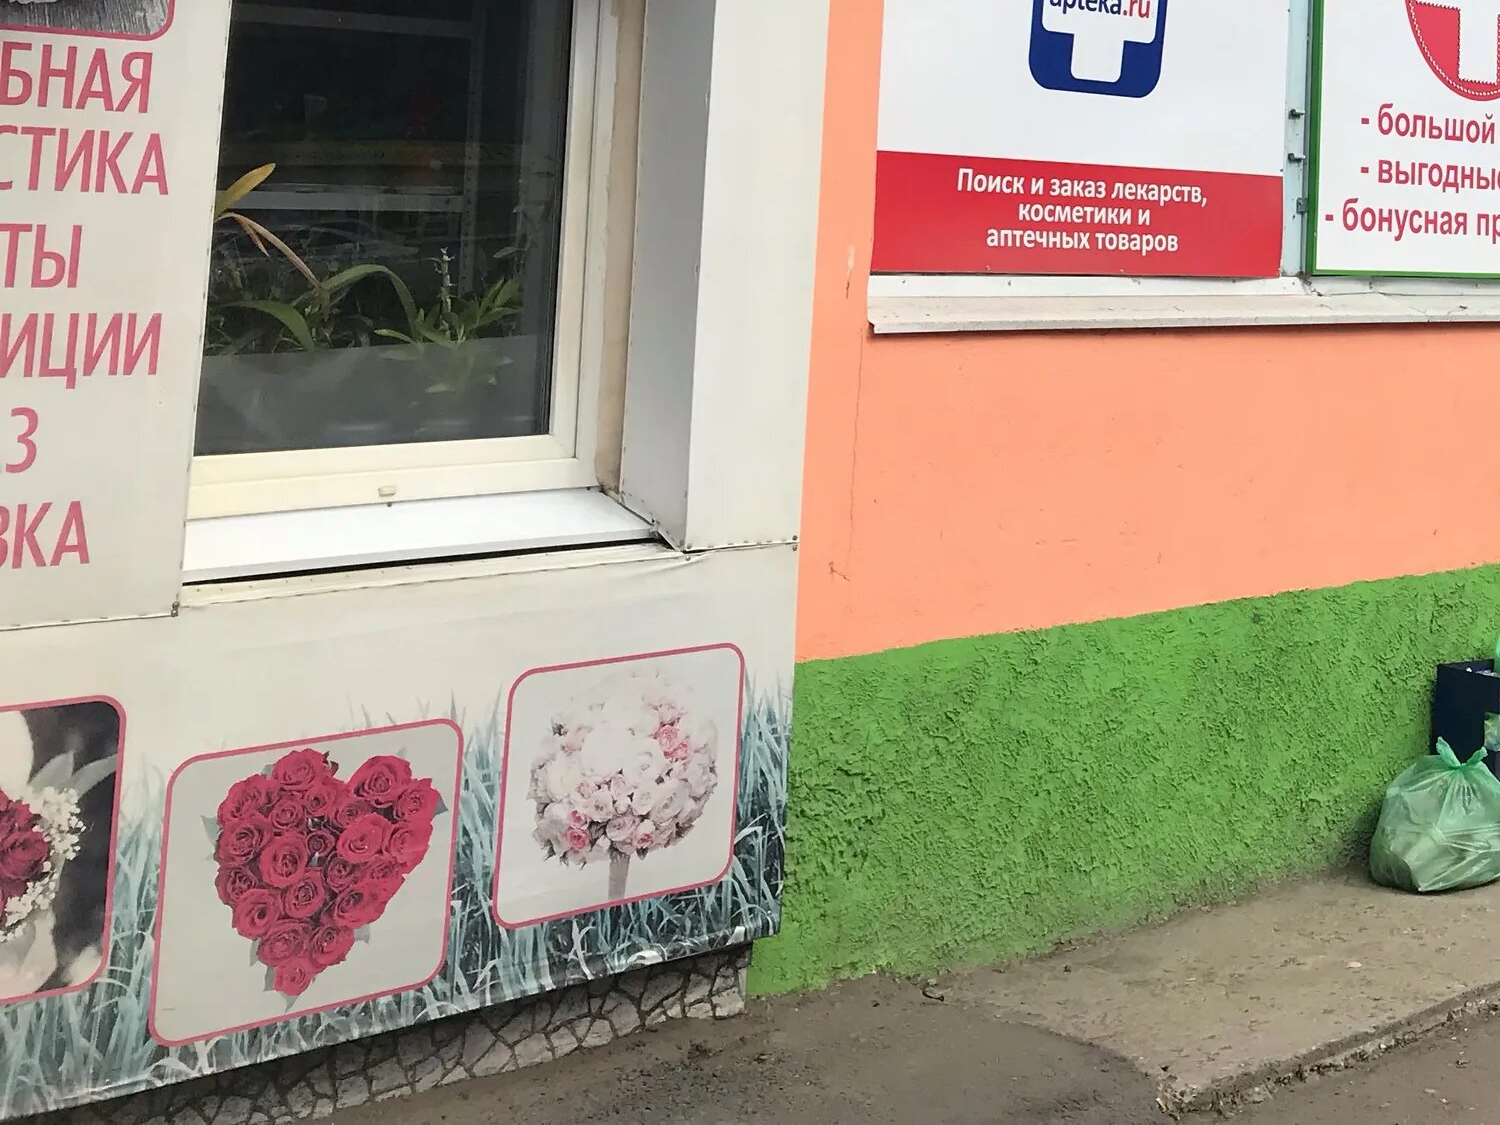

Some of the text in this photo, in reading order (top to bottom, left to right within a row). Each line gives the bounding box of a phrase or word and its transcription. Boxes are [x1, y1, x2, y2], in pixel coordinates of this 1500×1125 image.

[0, 41, 153, 113] БНАЯ
[1378, 103, 1495, 145] большой
[957, 168, 1208, 207] Поиск и заказ лекарств,
[1018, 203, 1151, 226] косметики и
[1342, 197, 1468, 242] бонусная
[0, 223, 83, 288] ТЫ
[987, 228, 1179, 256] аптечных товаров
[0, 313, 162, 389] ИЦИИ
